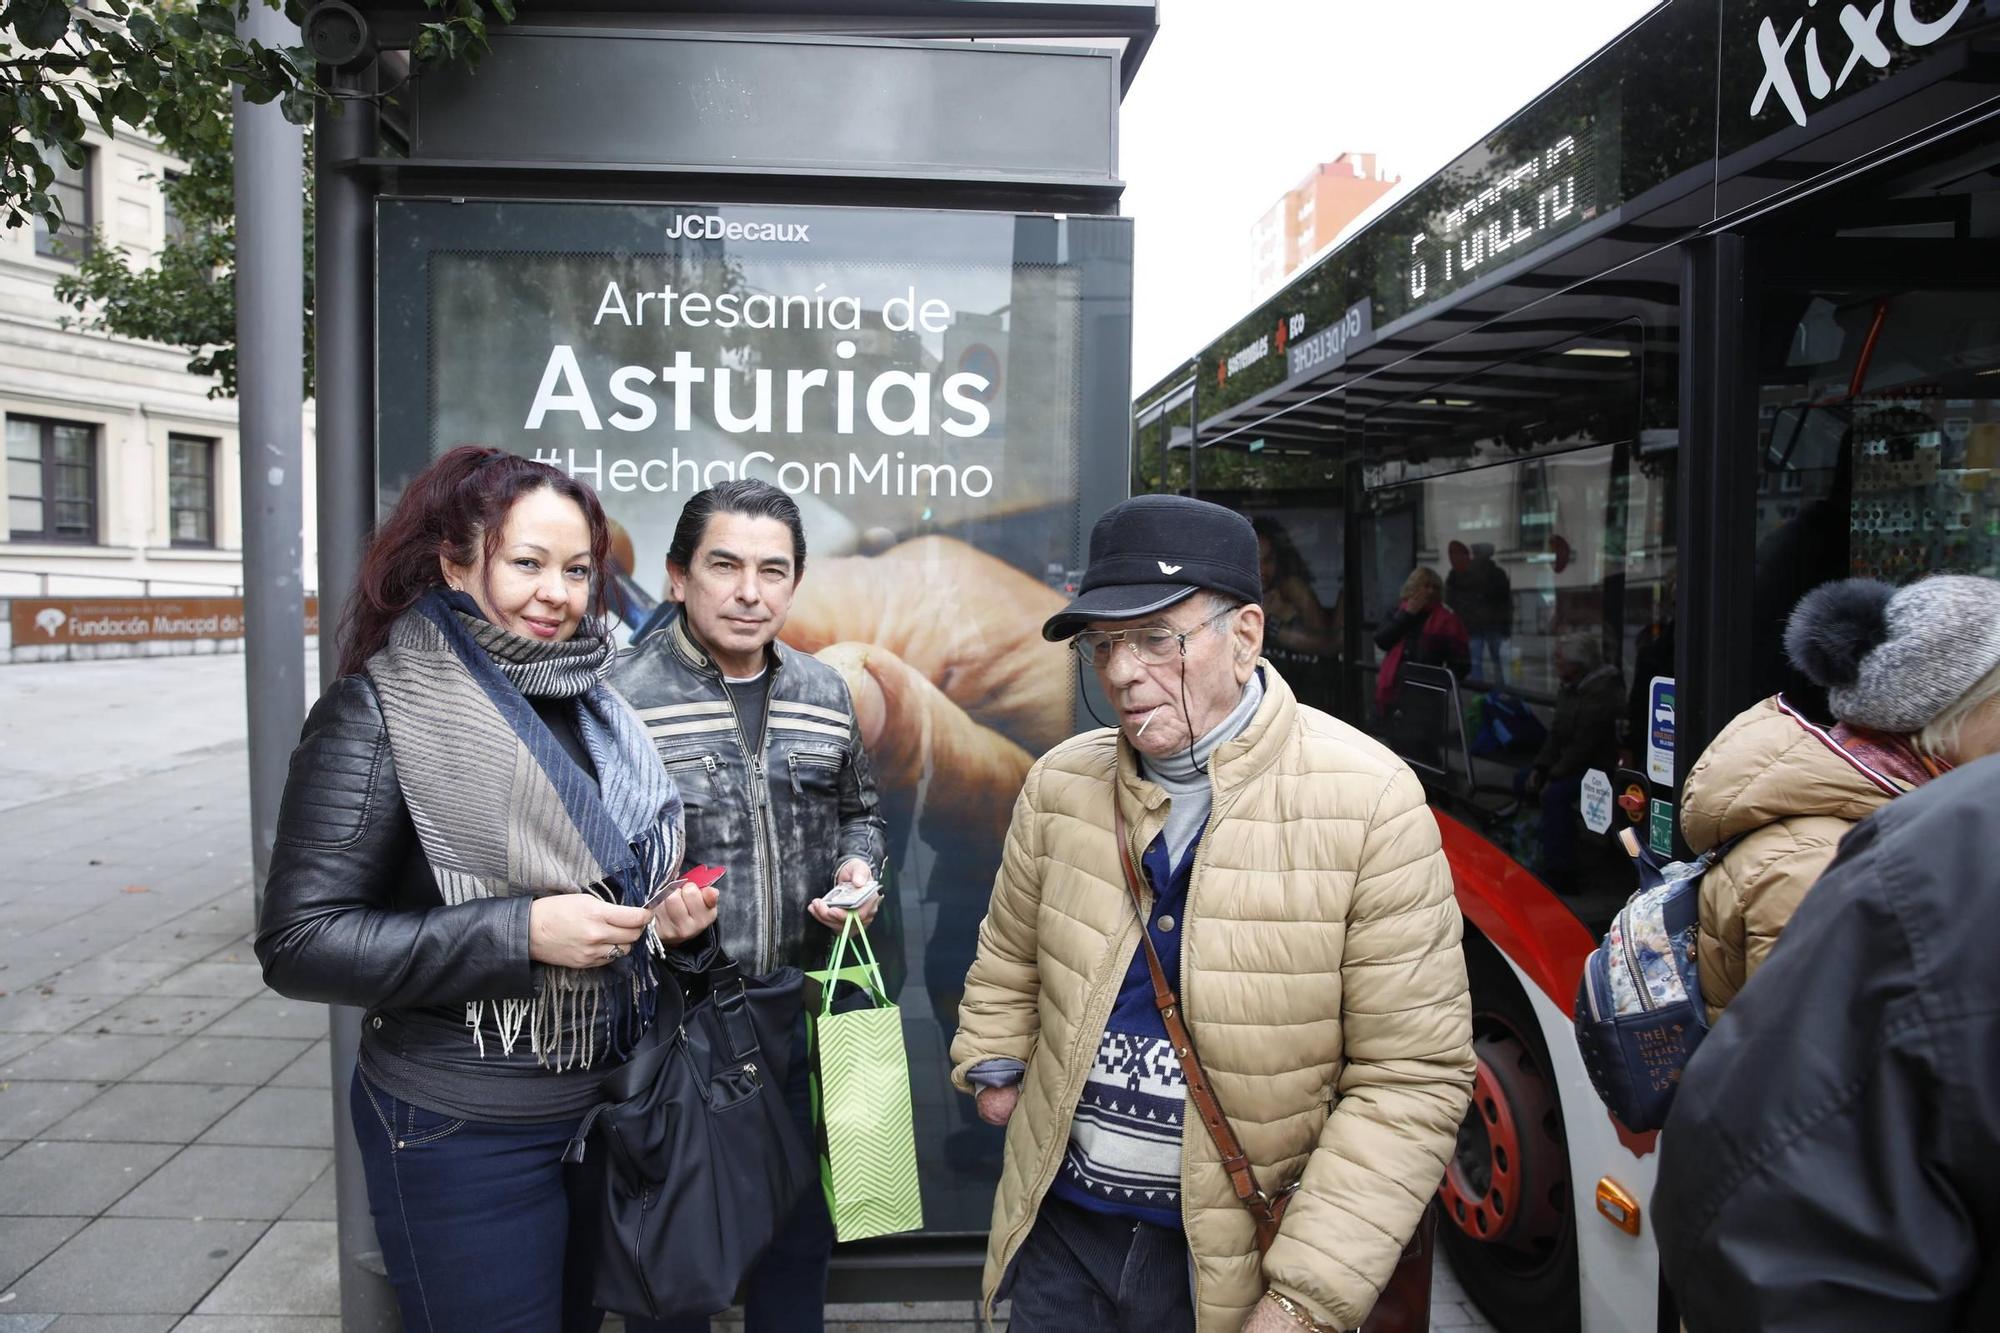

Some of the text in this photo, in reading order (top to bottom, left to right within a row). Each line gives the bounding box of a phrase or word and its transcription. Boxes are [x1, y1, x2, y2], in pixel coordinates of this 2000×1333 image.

[666, 214, 810, 243] JCDecaux
[594, 281, 950, 333] Artesanía de
[524, 340, 991, 438] Asturias
[152, 615, 219, 636] Municipal
